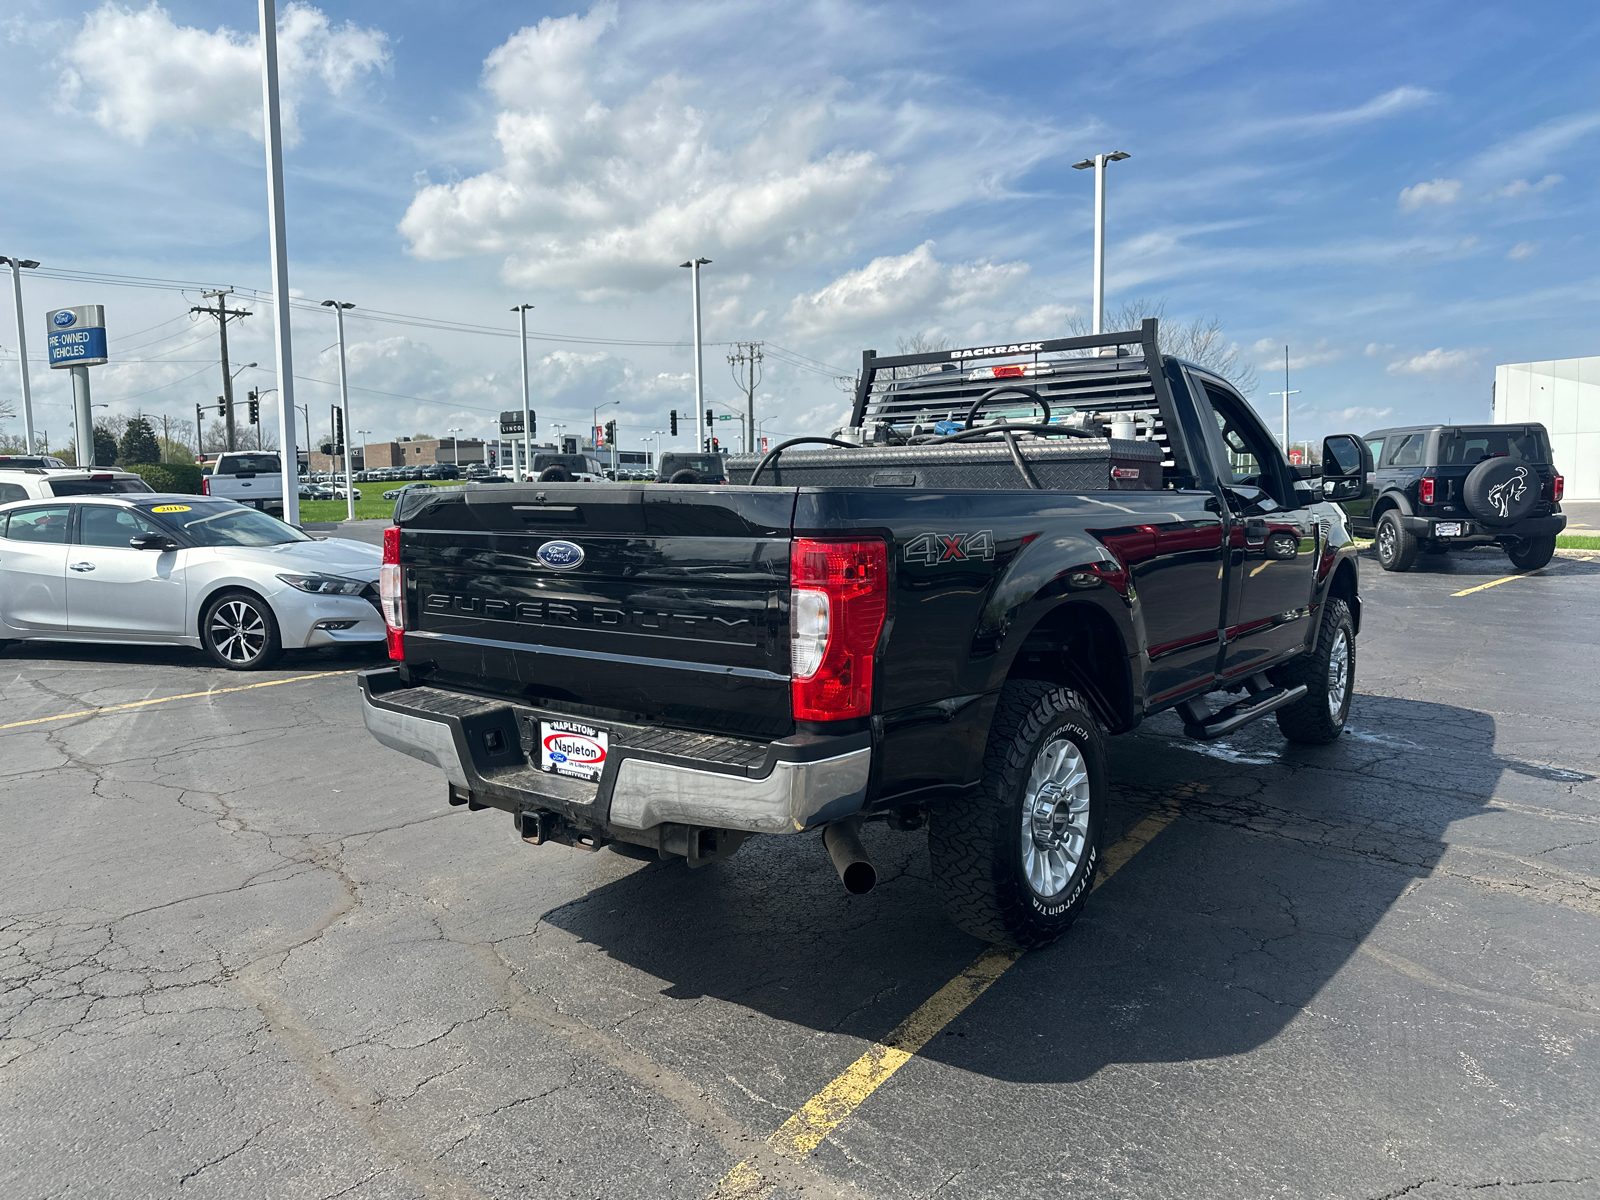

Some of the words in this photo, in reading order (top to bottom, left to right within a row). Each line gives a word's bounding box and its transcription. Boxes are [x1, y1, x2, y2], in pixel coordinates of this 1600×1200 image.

[56, 312, 69, 324] Ford
[49, 332, 89, 347] PRE-OWNED
[53, 345, 84, 358] VEHICLES
[950, 343, 1043, 359] BACKRACK
[548, 546, 571, 563] Ford
[427, 593, 578, 621] SUPER
[593, 606, 749, 635] DUTY
[553, 721, 593, 736] NAPLETON
[555, 738, 596, 758] Napleton
[558, 768, 591, 780] LIBERTYVILLE
